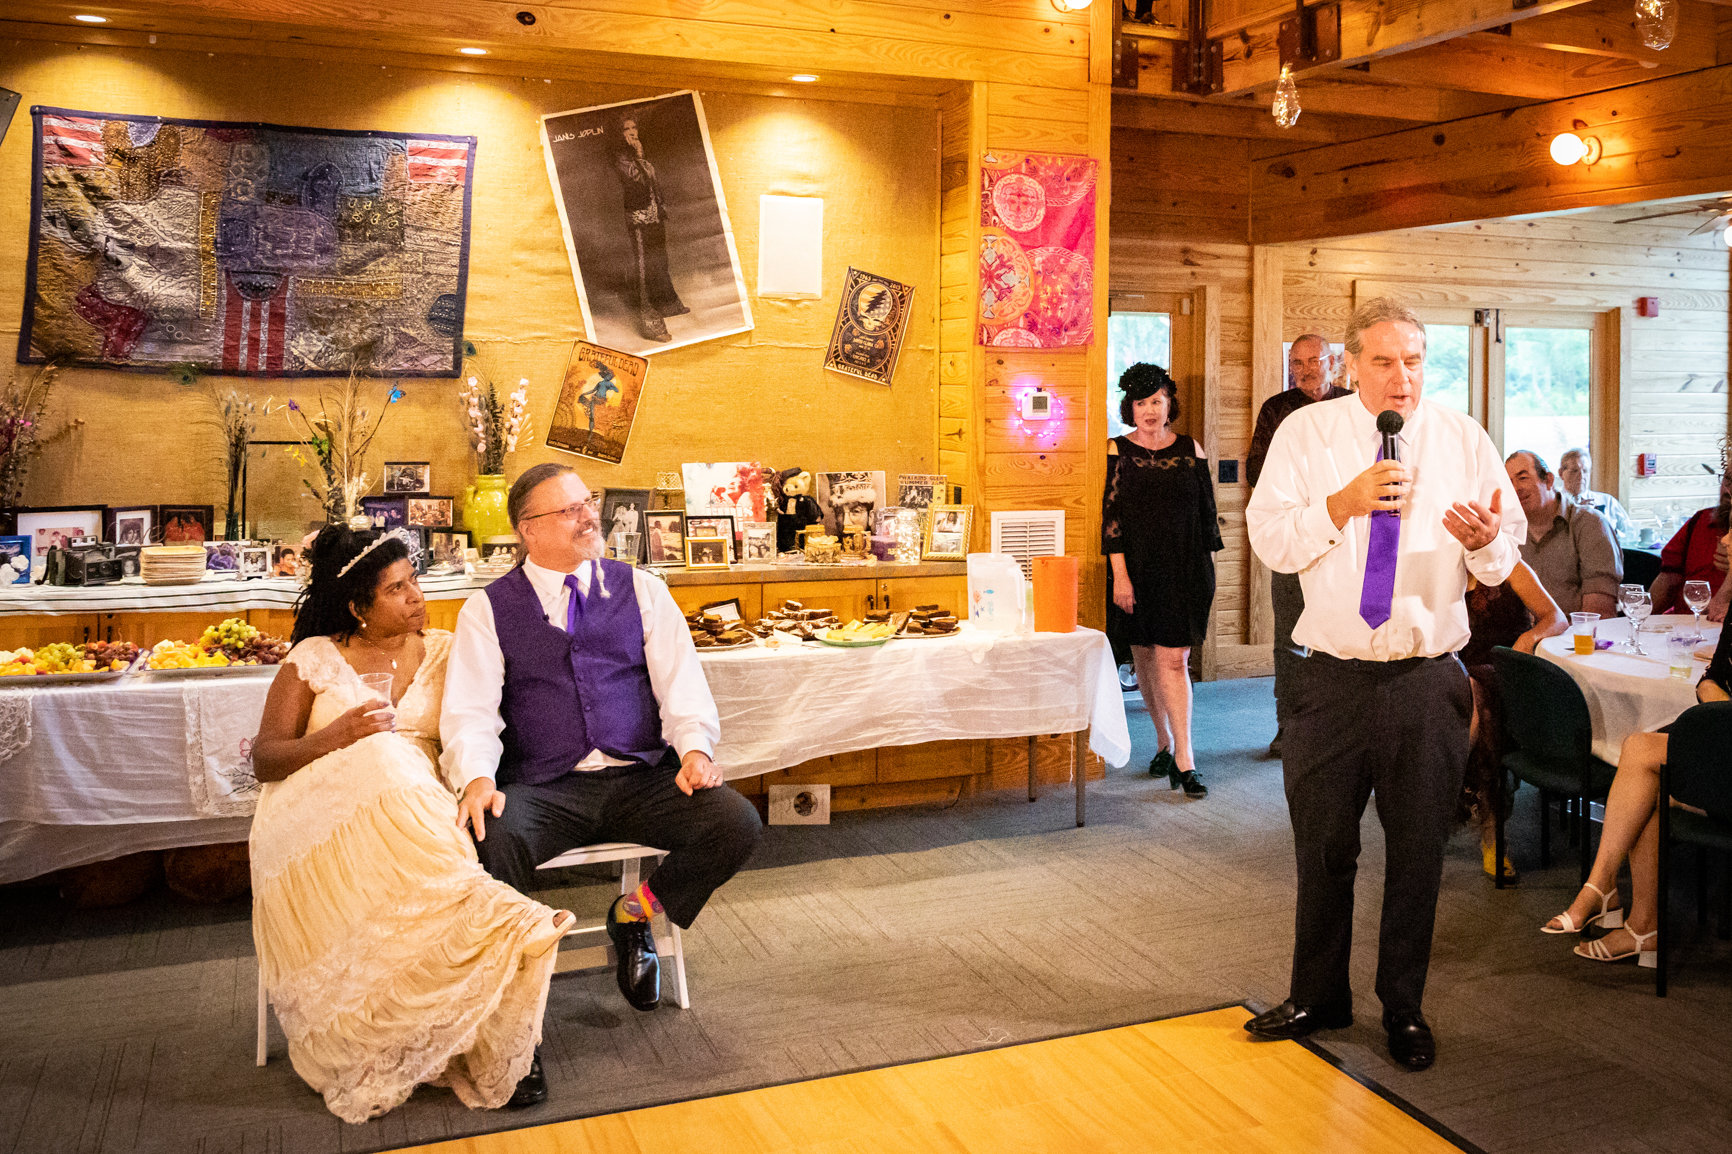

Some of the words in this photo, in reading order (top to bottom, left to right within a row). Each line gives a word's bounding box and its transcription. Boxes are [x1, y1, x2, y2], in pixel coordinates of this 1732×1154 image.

[578, 347, 618, 368] GRATEFUL
[618, 358, 640, 377] DEAD
[837, 363, 863, 375] GRATEFUL
[864, 371, 878, 380] DEAD
